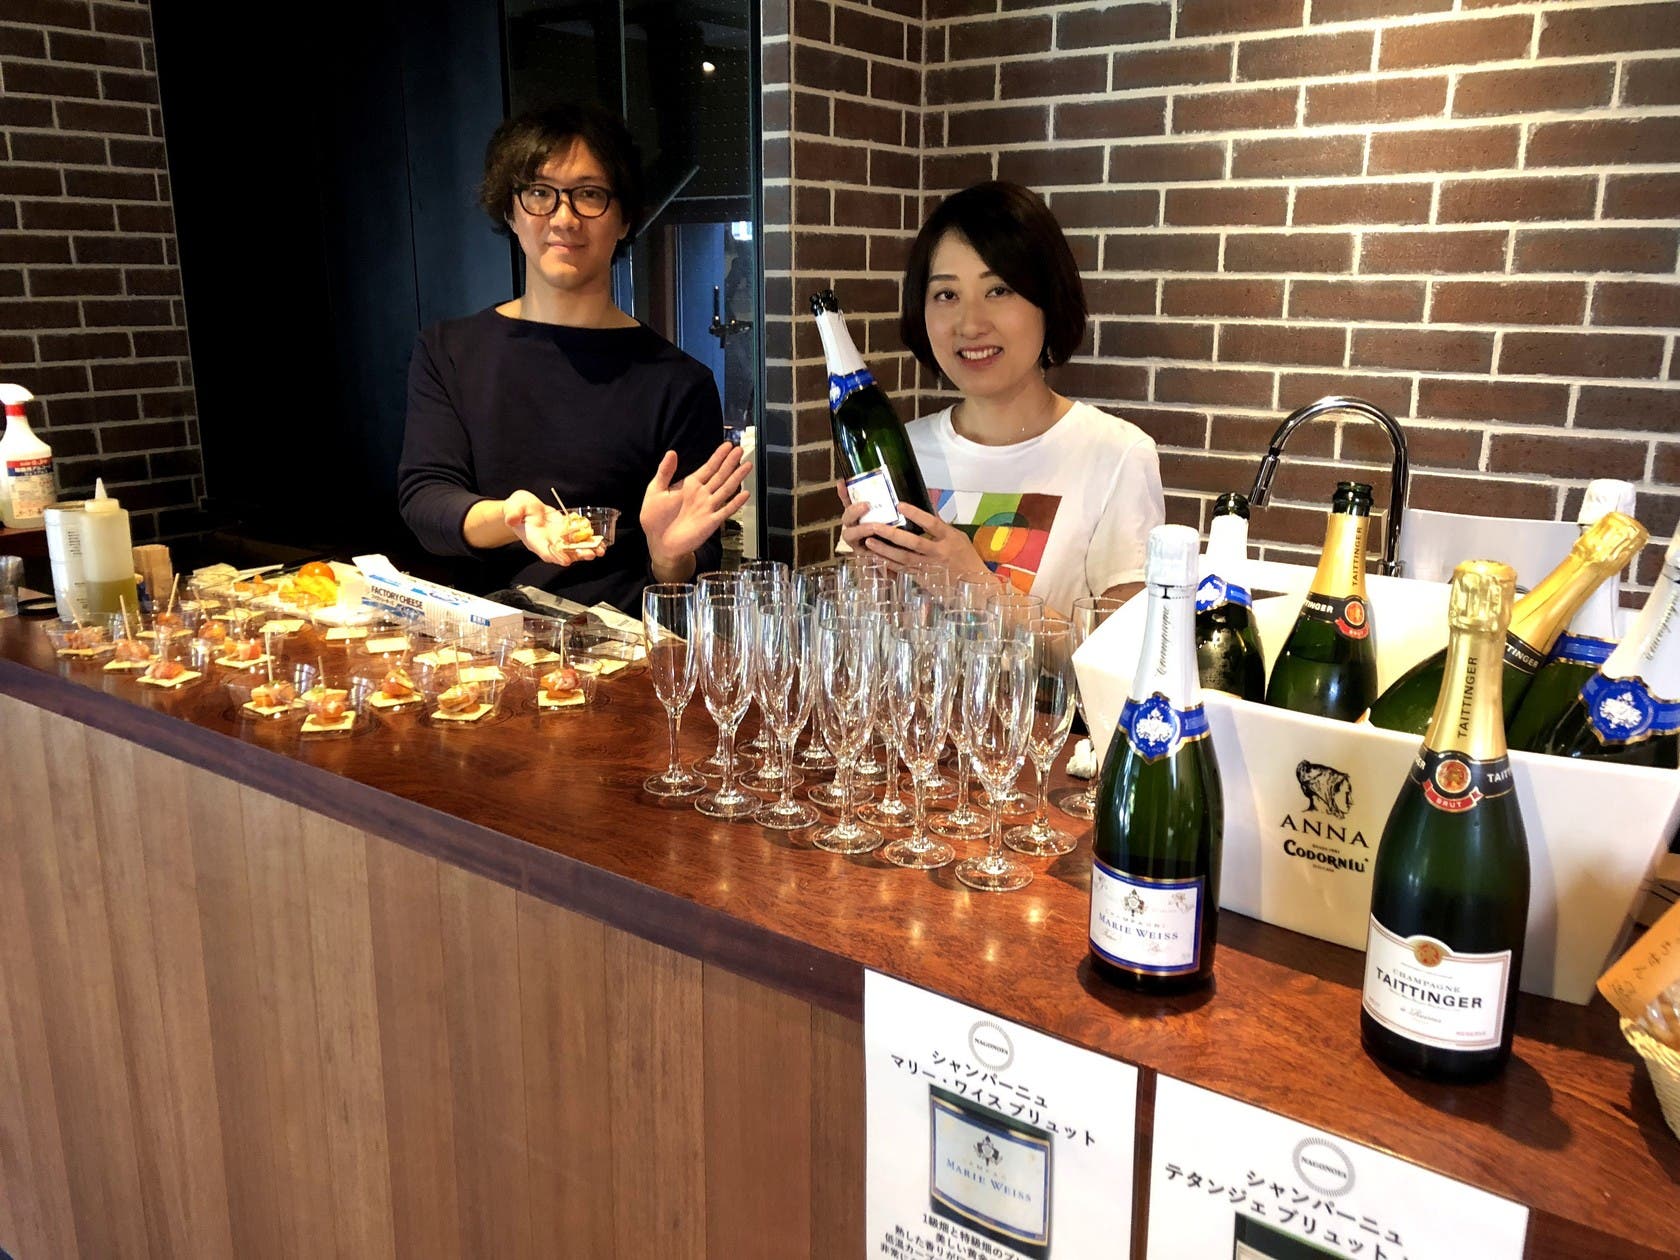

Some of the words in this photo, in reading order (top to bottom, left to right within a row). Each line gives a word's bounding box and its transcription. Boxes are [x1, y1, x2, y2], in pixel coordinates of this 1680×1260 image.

[1352, 527, 1363, 587] TAITTINGER
[371, 585, 399, 603] FACTORY
[399, 595, 424, 610] CHEESE
[1457, 656, 1478, 739] TAITTINGER
[1435, 797, 1462, 809] BRUT
[1280, 813, 1369, 848] ANNA
[1098, 911, 1132, 935] MARIE
[1135, 927, 1179, 941] WEISS
[1376, 966, 1482, 1009] TAITTINGER
[1392, 967, 1461, 994] CHAMPAGNE
[931, 1050, 1048, 1109] シャンパーニュ
[946, 1157, 986, 1186] MARIE
[990, 1179, 1032, 1203] WEISS
[1246, 1170, 1404, 1247] シャンパーニュ
